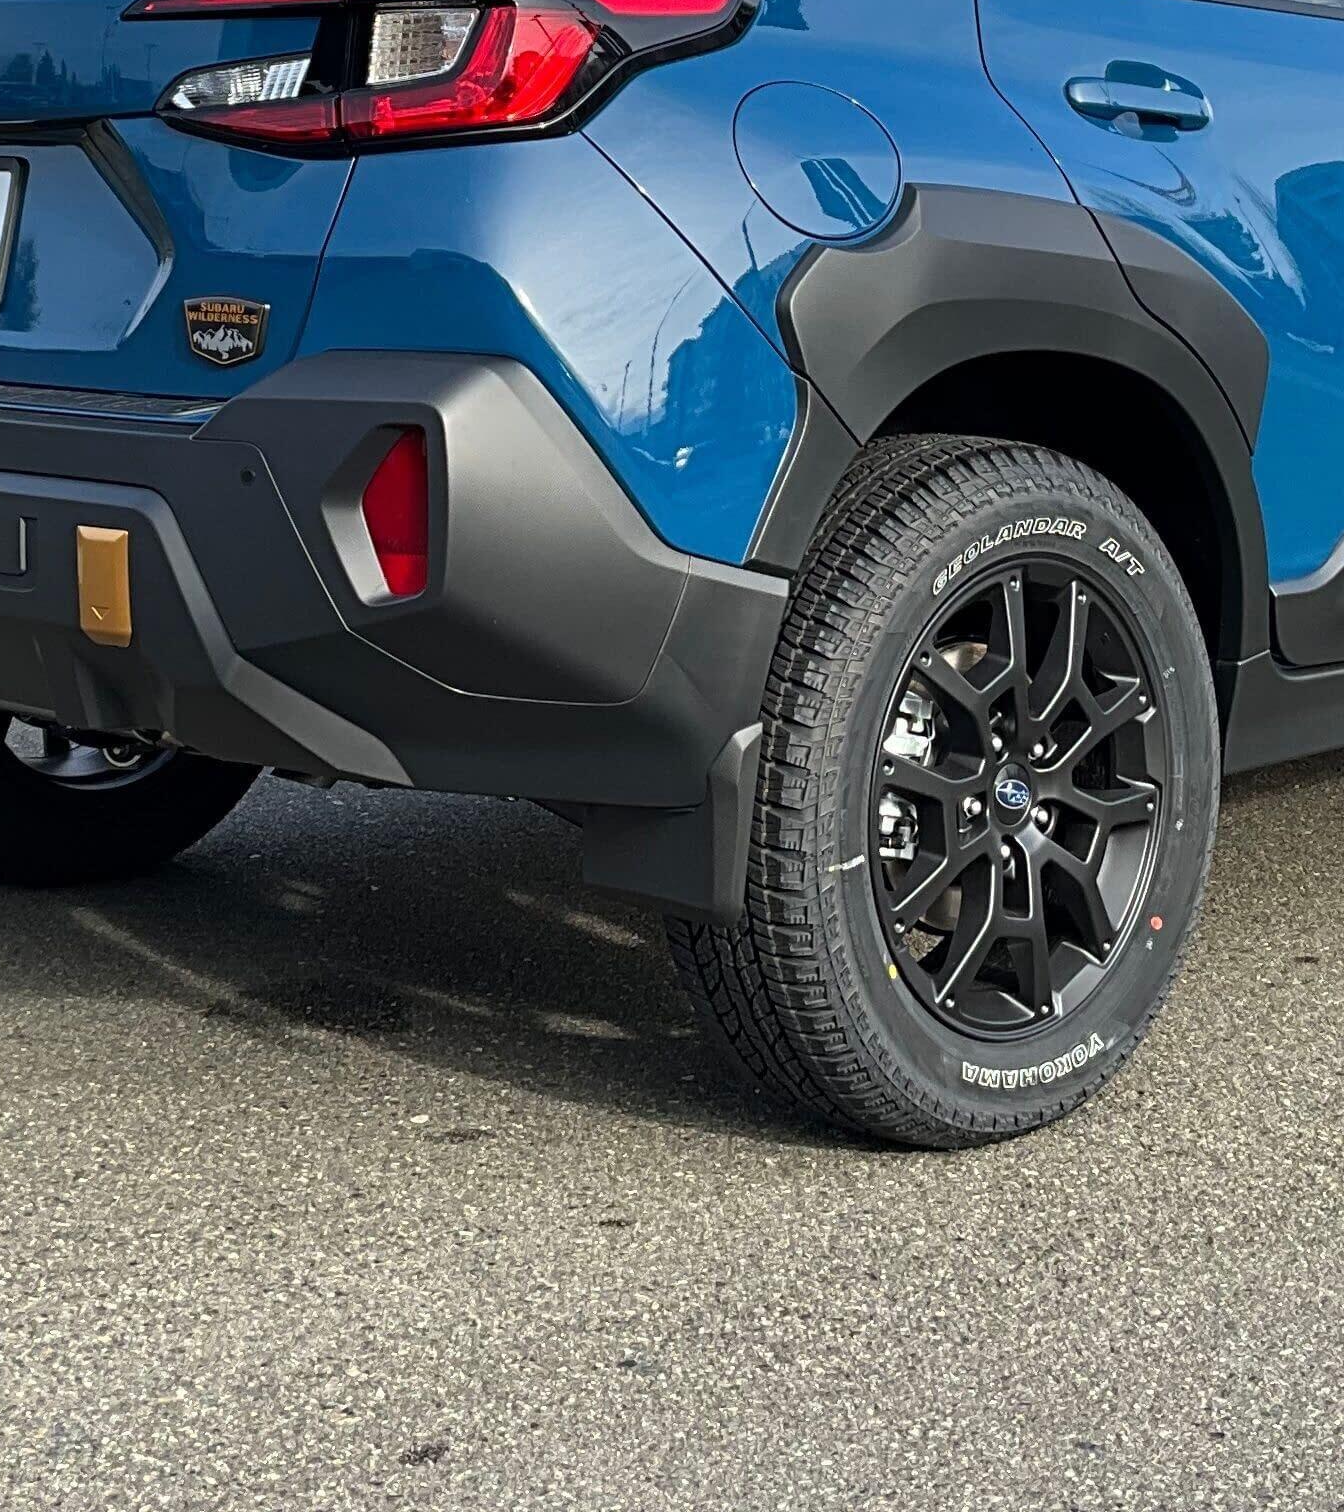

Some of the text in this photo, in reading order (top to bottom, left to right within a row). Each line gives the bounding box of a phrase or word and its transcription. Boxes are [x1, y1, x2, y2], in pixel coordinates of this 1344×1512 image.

[188, 311, 259, 324] WILDERNESS
[200, 302, 245, 314] SUBARU
[932, 517, 1145, 595] GEOLANDAR A/T
[962, 1032, 1105, 1089] YOKOHAMA
